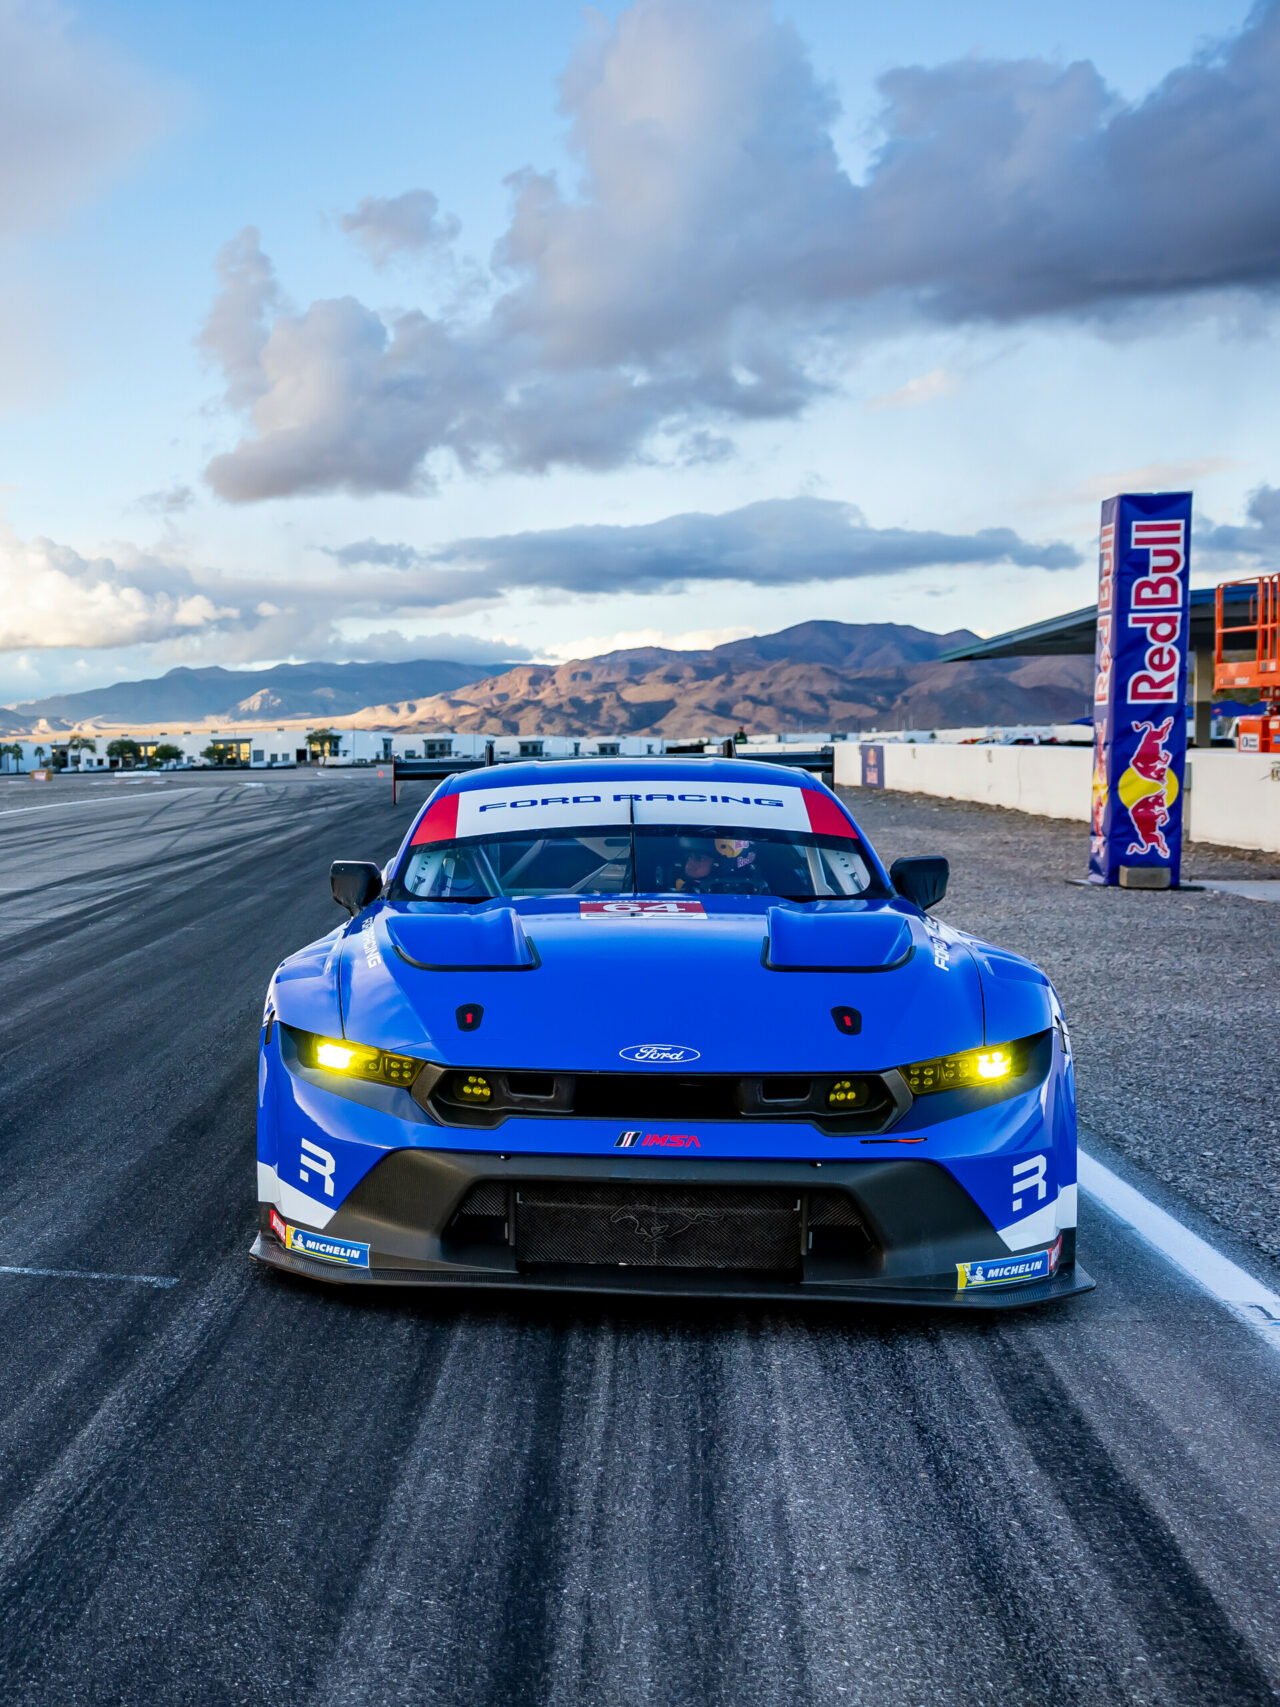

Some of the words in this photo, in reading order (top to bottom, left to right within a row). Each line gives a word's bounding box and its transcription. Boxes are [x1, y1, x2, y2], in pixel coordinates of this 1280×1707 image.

[1099, 523, 1115, 612] Bull
[1131, 519, 1185, 609] Bull
[1095, 614, 1112, 705] Red
[1128, 612, 1181, 704] Red
[479, 795, 602, 813] FORD
[613, 794, 784, 807] RACING
[602, 903, 686, 912] 64
[635, 1046, 685, 1061] Ford
[641, 1134, 701, 1148] IMSA
[305, 1239, 361, 1259] MICHELIN
[986, 1260, 1043, 1279] MICHELIN
